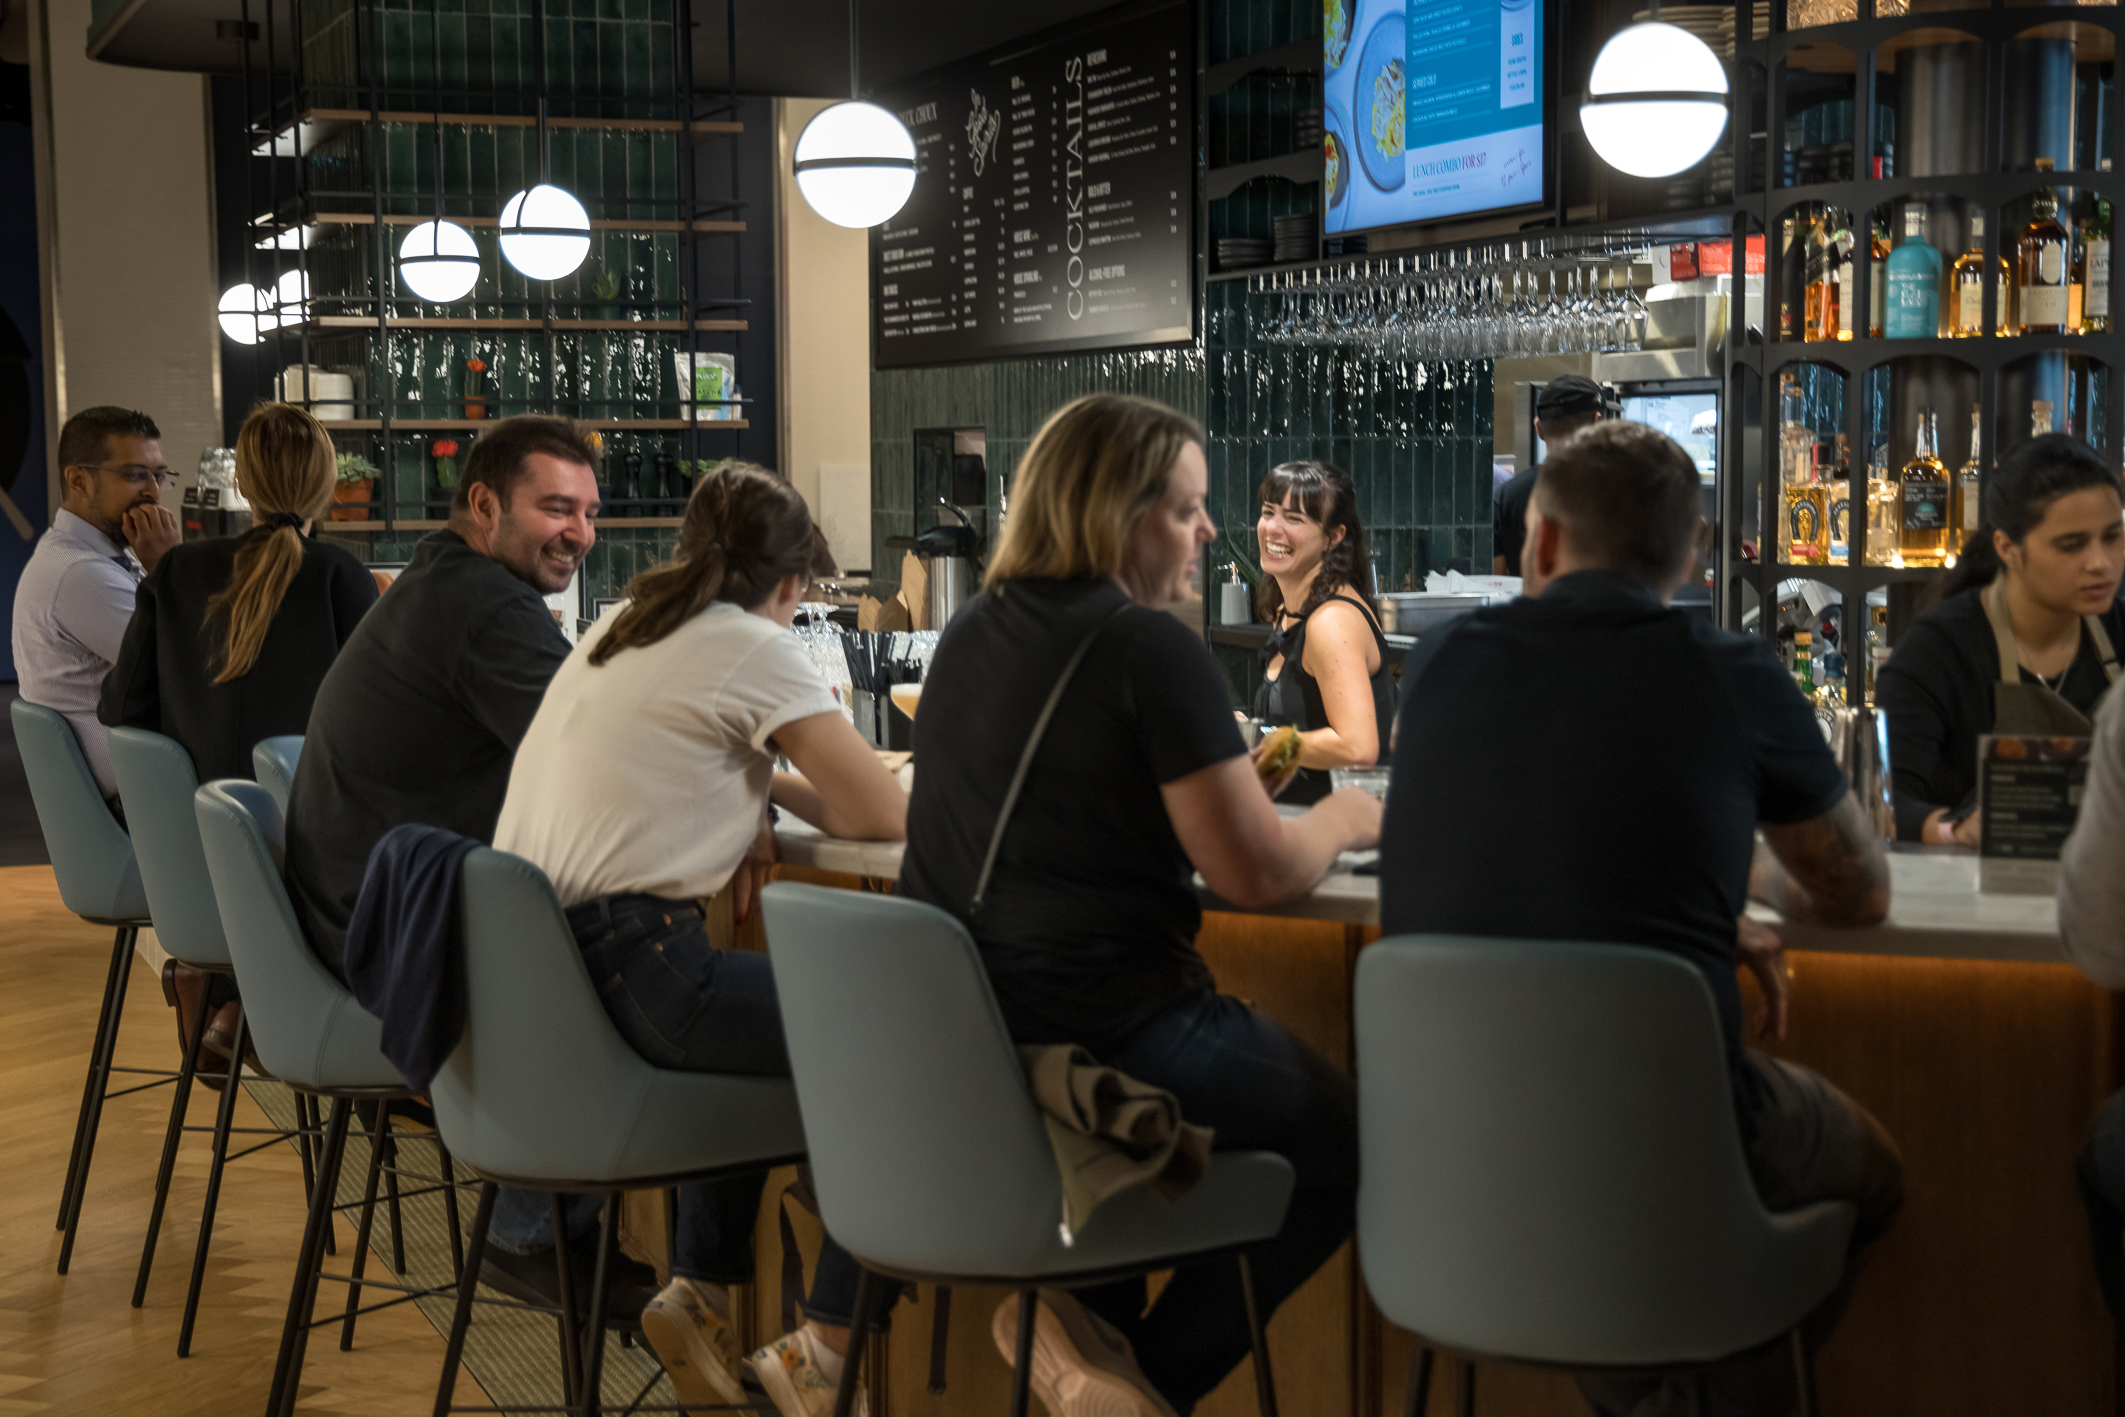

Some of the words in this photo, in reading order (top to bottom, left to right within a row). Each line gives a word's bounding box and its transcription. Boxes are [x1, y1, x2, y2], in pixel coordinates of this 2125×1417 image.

[1065, 56, 1084, 321] COCKTAILS
[1413, 161, 1436, 179] LUNCH
[1436, 156, 1461, 175] COMBO
[1462, 154, 1476, 170] FOR
